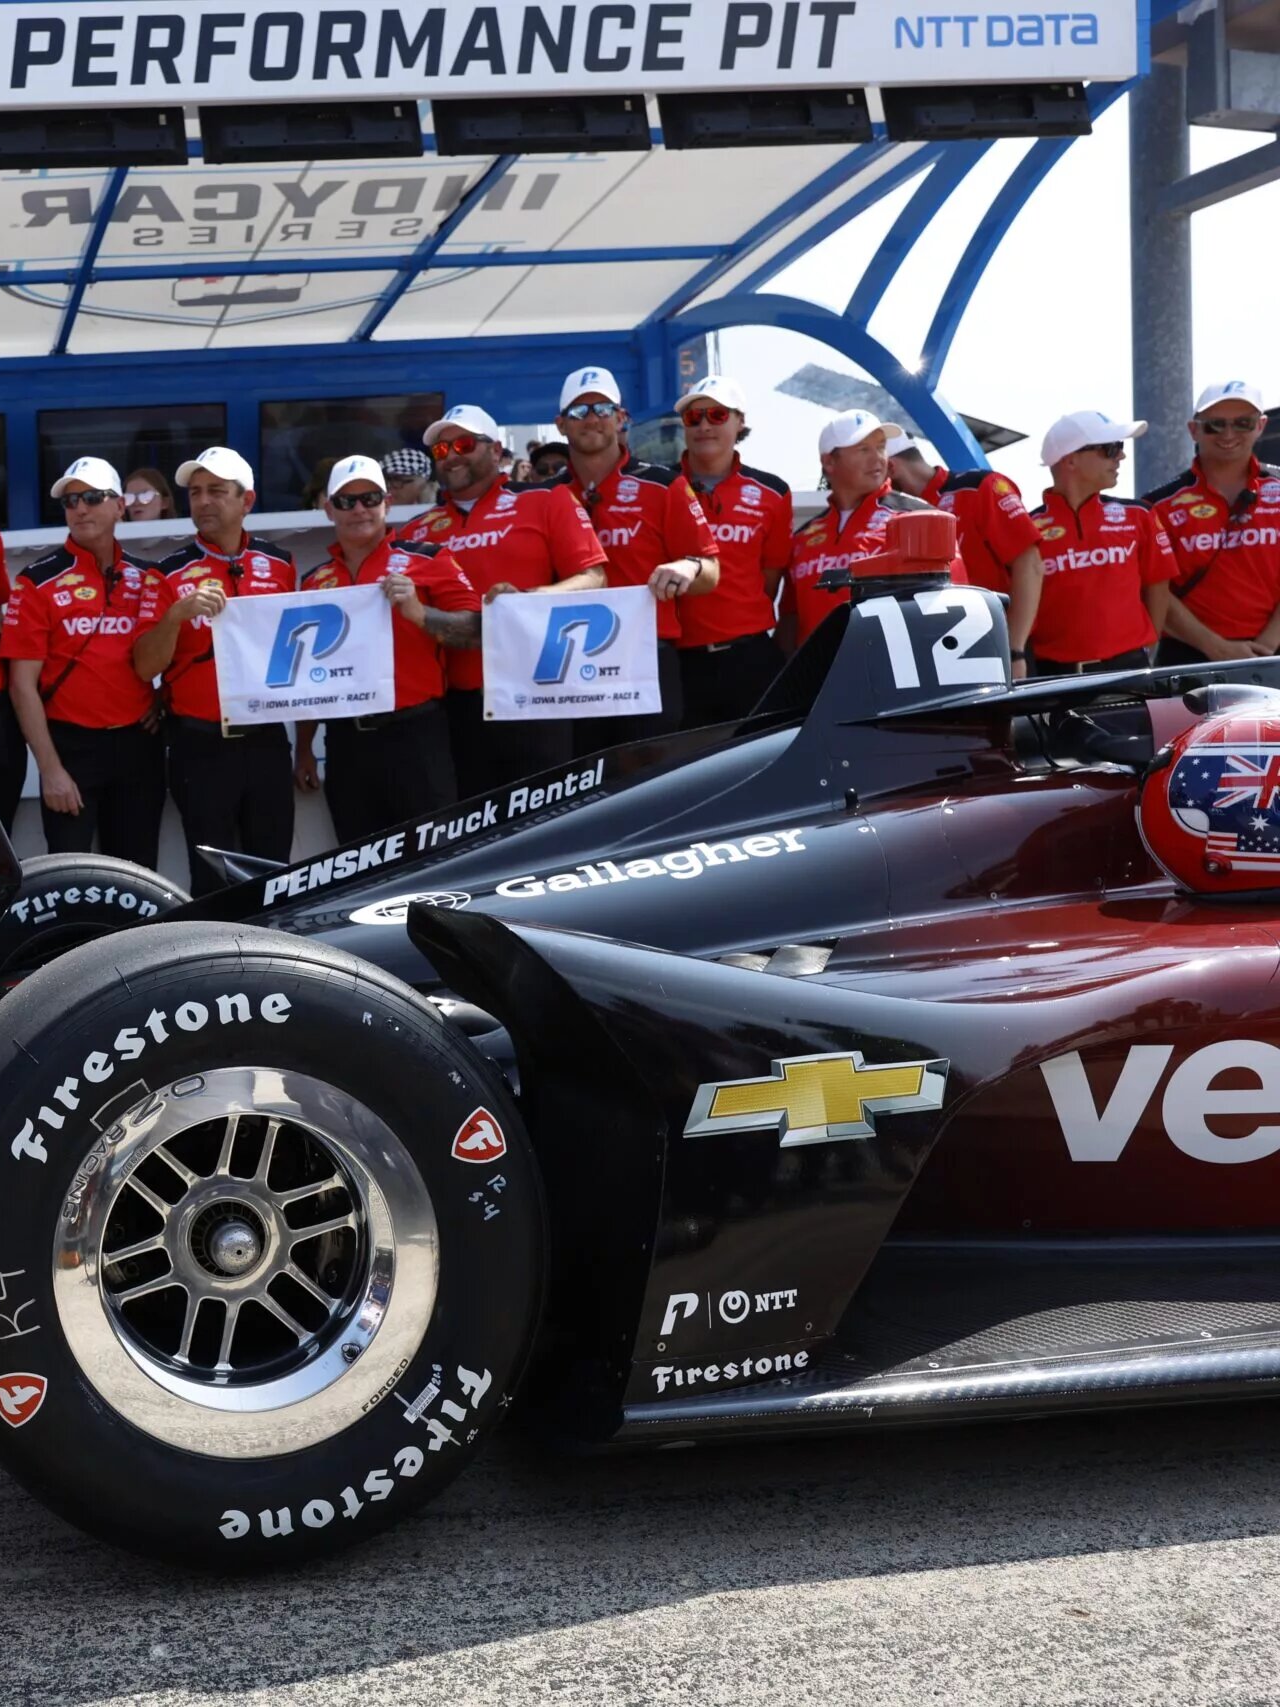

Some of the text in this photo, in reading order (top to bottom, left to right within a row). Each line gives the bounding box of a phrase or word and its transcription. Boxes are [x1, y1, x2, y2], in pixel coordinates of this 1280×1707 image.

[10, 1, 856, 88] PERFORMANCE PIT
[895, 15, 978, 49] NTT
[1180, 527, 1277, 553] verizon
[1042, 547, 1126, 576] erizon
[856, 588, 1006, 689] 12
[330, 666, 354, 678] NTT
[599, 666, 620, 677] NTT
[266, 699, 289, 710] IOWA
[291, 695, 339, 707] SPEEDWAY
[346, 692, 371, 702] RACE
[263, 758, 604, 906] PENSKE Truck Rental
[495, 827, 808, 898] Gallagher
[10, 885, 158, 923] Fireston
[11, 992, 292, 1164] Firestone
[755, 1288, 798, 1313] NTT
[361, 1358, 409, 1413] FORGED
[651, 1350, 809, 1393] Firestone
[218, 1364, 493, 1540] Firestone
